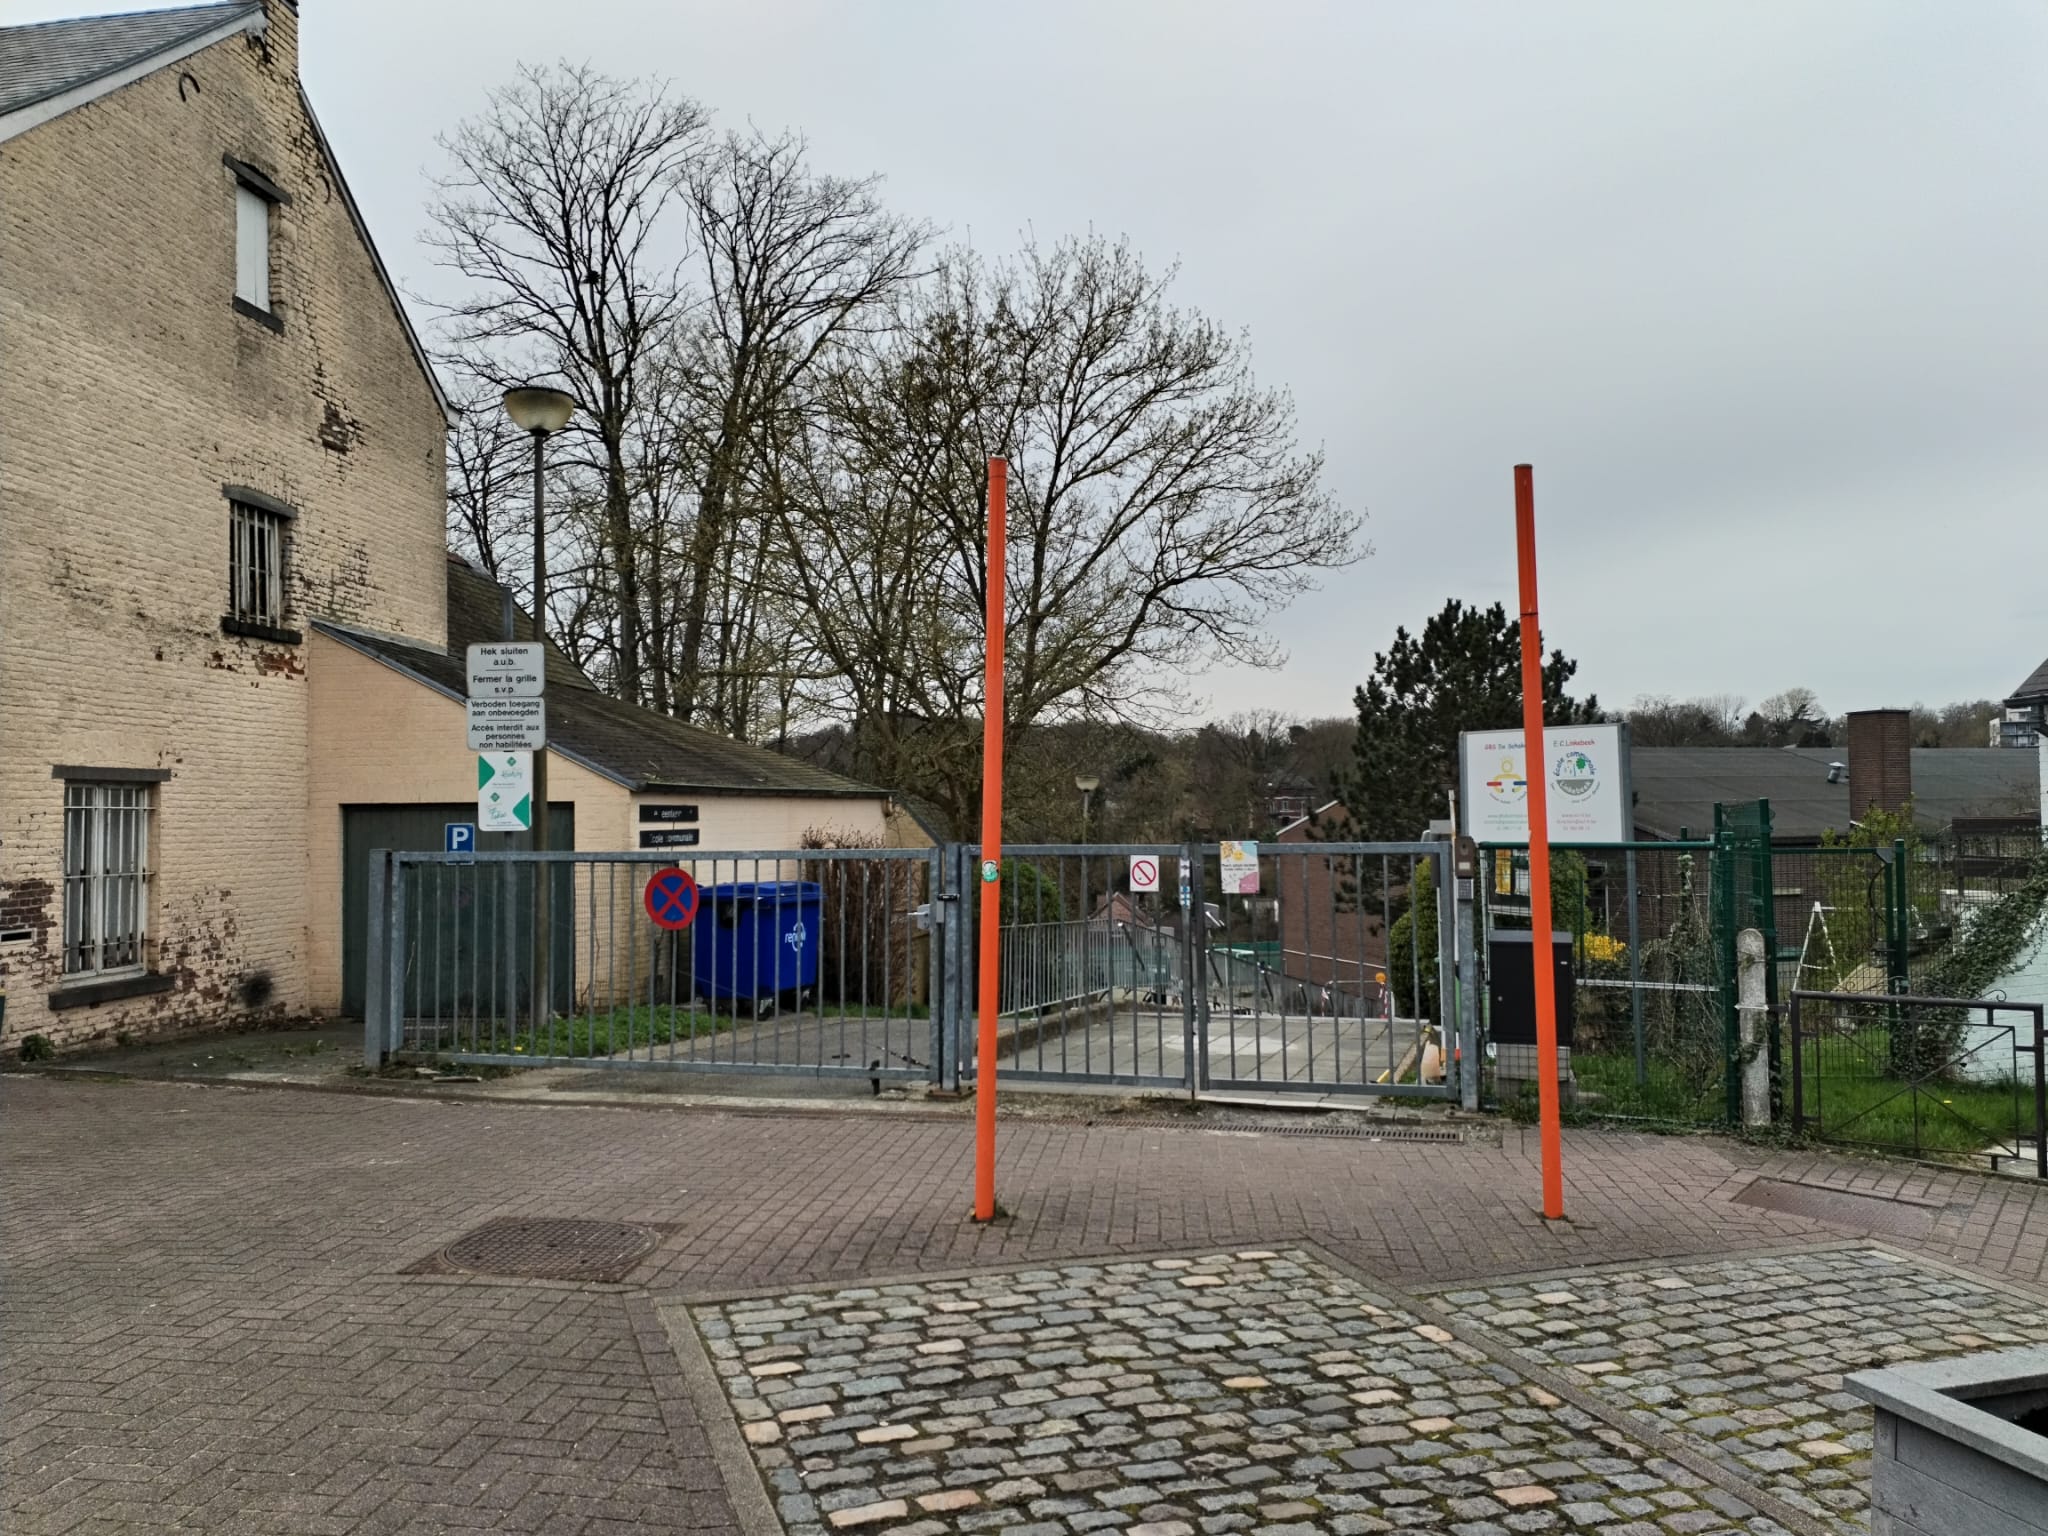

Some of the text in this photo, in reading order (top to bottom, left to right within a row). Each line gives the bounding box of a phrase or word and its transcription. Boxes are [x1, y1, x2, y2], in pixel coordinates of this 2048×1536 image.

[480, 647, 528, 655] Hek sluiten
[472, 674, 537, 684] Fermer la grille
[471, 700, 540, 708] Verboden toegang
[472, 708, 539, 717] aan onbevoegden
[471, 723, 494, 732] Accès
[496, 724, 523, 732] interdit
[485, 733, 525, 741] personnes
[479, 741, 532, 749] non habilitées
[452, 827, 469, 850] P
